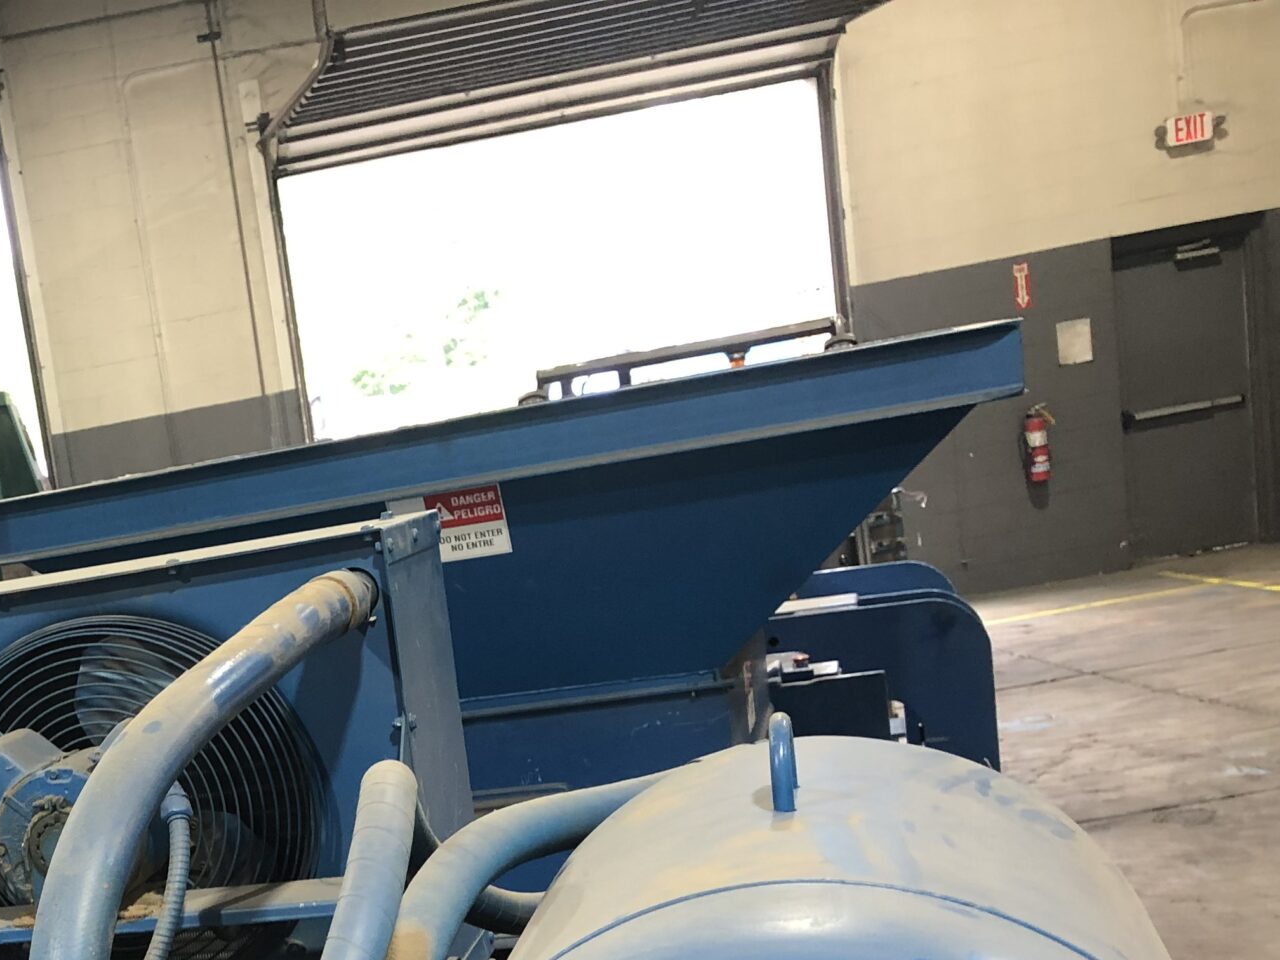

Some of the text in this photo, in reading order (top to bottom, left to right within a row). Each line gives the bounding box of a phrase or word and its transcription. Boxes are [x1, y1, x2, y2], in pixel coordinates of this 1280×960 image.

[1174, 112, 1206, 143] EXIT
[451, 491, 496, 507] DANGER
[453, 503, 502, 520] PELIGRO
[439, 527, 503, 545] DO NOT ENTER
[450, 539, 495, 552] NO ENTRE
